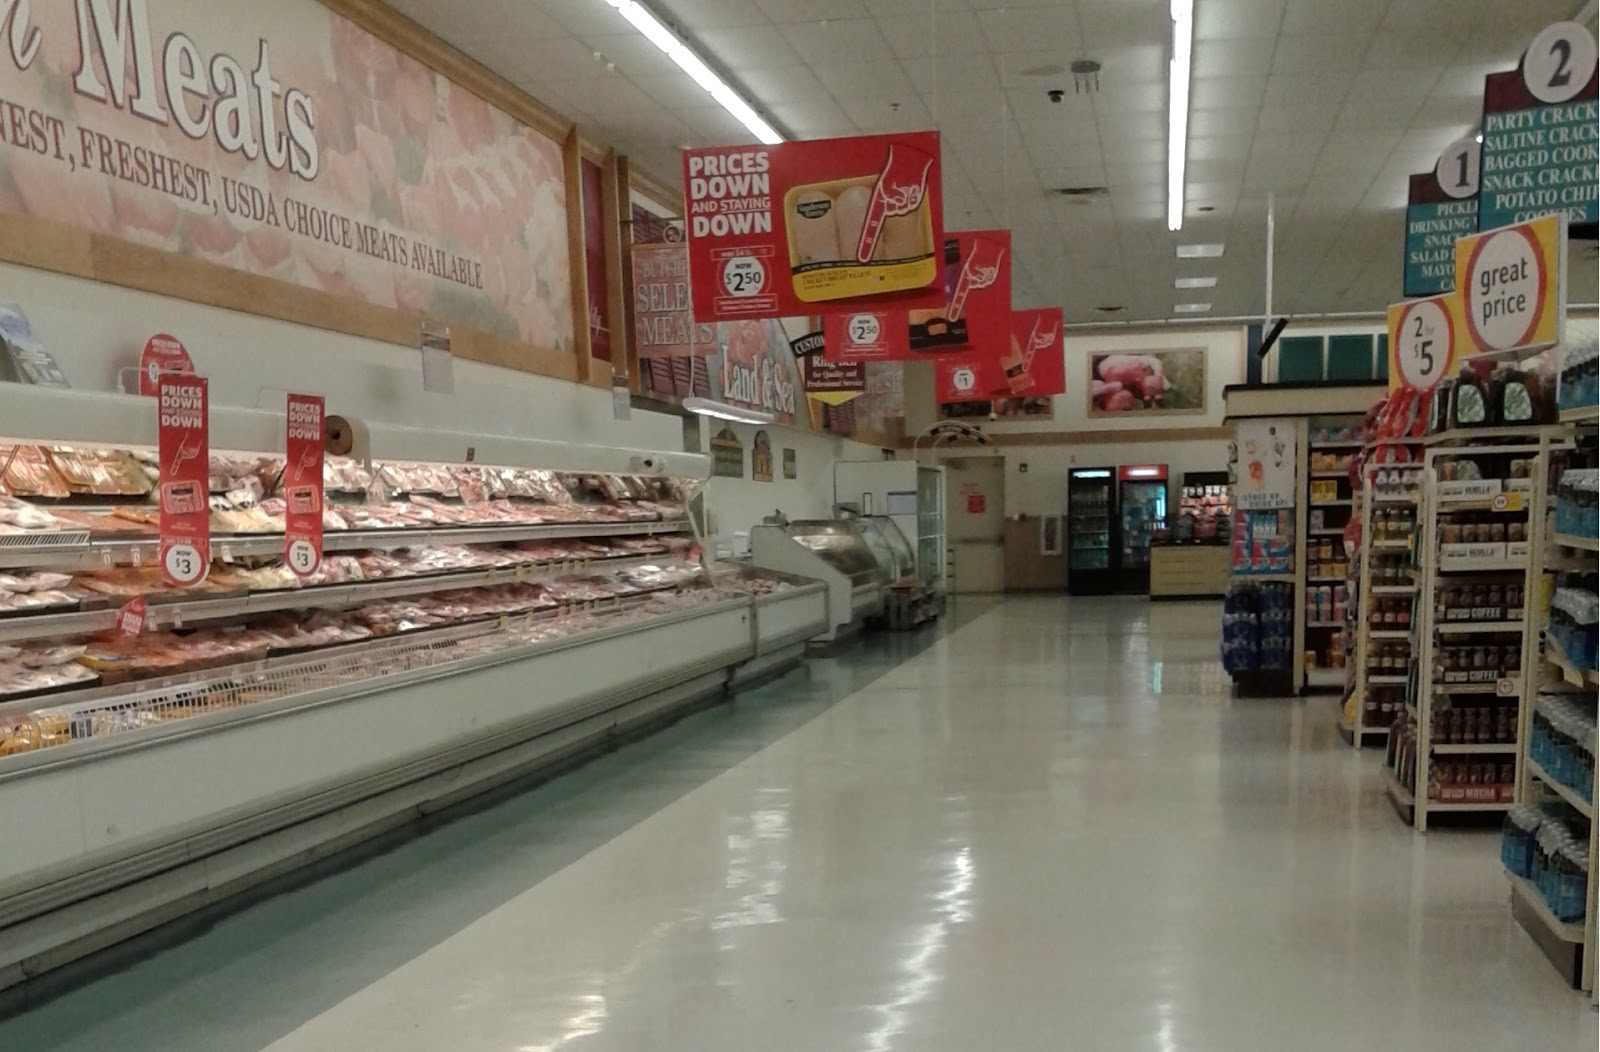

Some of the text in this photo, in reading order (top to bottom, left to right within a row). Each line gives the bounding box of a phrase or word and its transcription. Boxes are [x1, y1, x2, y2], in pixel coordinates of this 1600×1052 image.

[1548, 38, 1572, 88] 2
[72, 0, 319, 182] Meats
[1486, 102, 1598, 132] PARTY CRACK
[1484, 122, 1598, 152] SALTINE CRACK
[688, 151, 770, 178] PRICES
[1485, 143, 1598, 171] BAGGED COOK
[1455, 151, 1470, 188] 1
[690, 173, 771, 200] DOWN
[1482, 171, 1535, 192] SNACK
[77, 126, 219, 216] FRESHEST,
[221, 176, 280, 228] USDA
[284, 197, 353, 250] CHOICE
[354, 221, 409, 267] MEATS
[411, 241, 484, 290] AVAILABLE
[691, 197, 771, 214] AND STAYING
[1495, 189, 1558, 210] POTATO
[692, 211, 772, 238] DOWN
[1410, 217, 1471, 234] DRINKING
[1410, 249, 1449, 264] SALAD
[1480, 257, 1529, 296] great
[1482, 291, 1526, 326] price
[1413, 315, 1424, 338] 2
[721, 344, 760, 405] Land
[774, 361, 796, 415] Sea
[822, 370, 844, 380] Quality
[161, 384, 203, 398] PRICES
[161, 396, 203, 409] DOWN
[289, 402, 320, 415] PRICES
[161, 414, 203, 428] DOWN
[289, 412, 320, 423] DOWN
[289, 428, 320, 440] DOWN
[176, 557, 192, 575] $3
[1471, 607, 1501, 618] COFFEE
[1469, 670, 1499, 681] COFFEE
